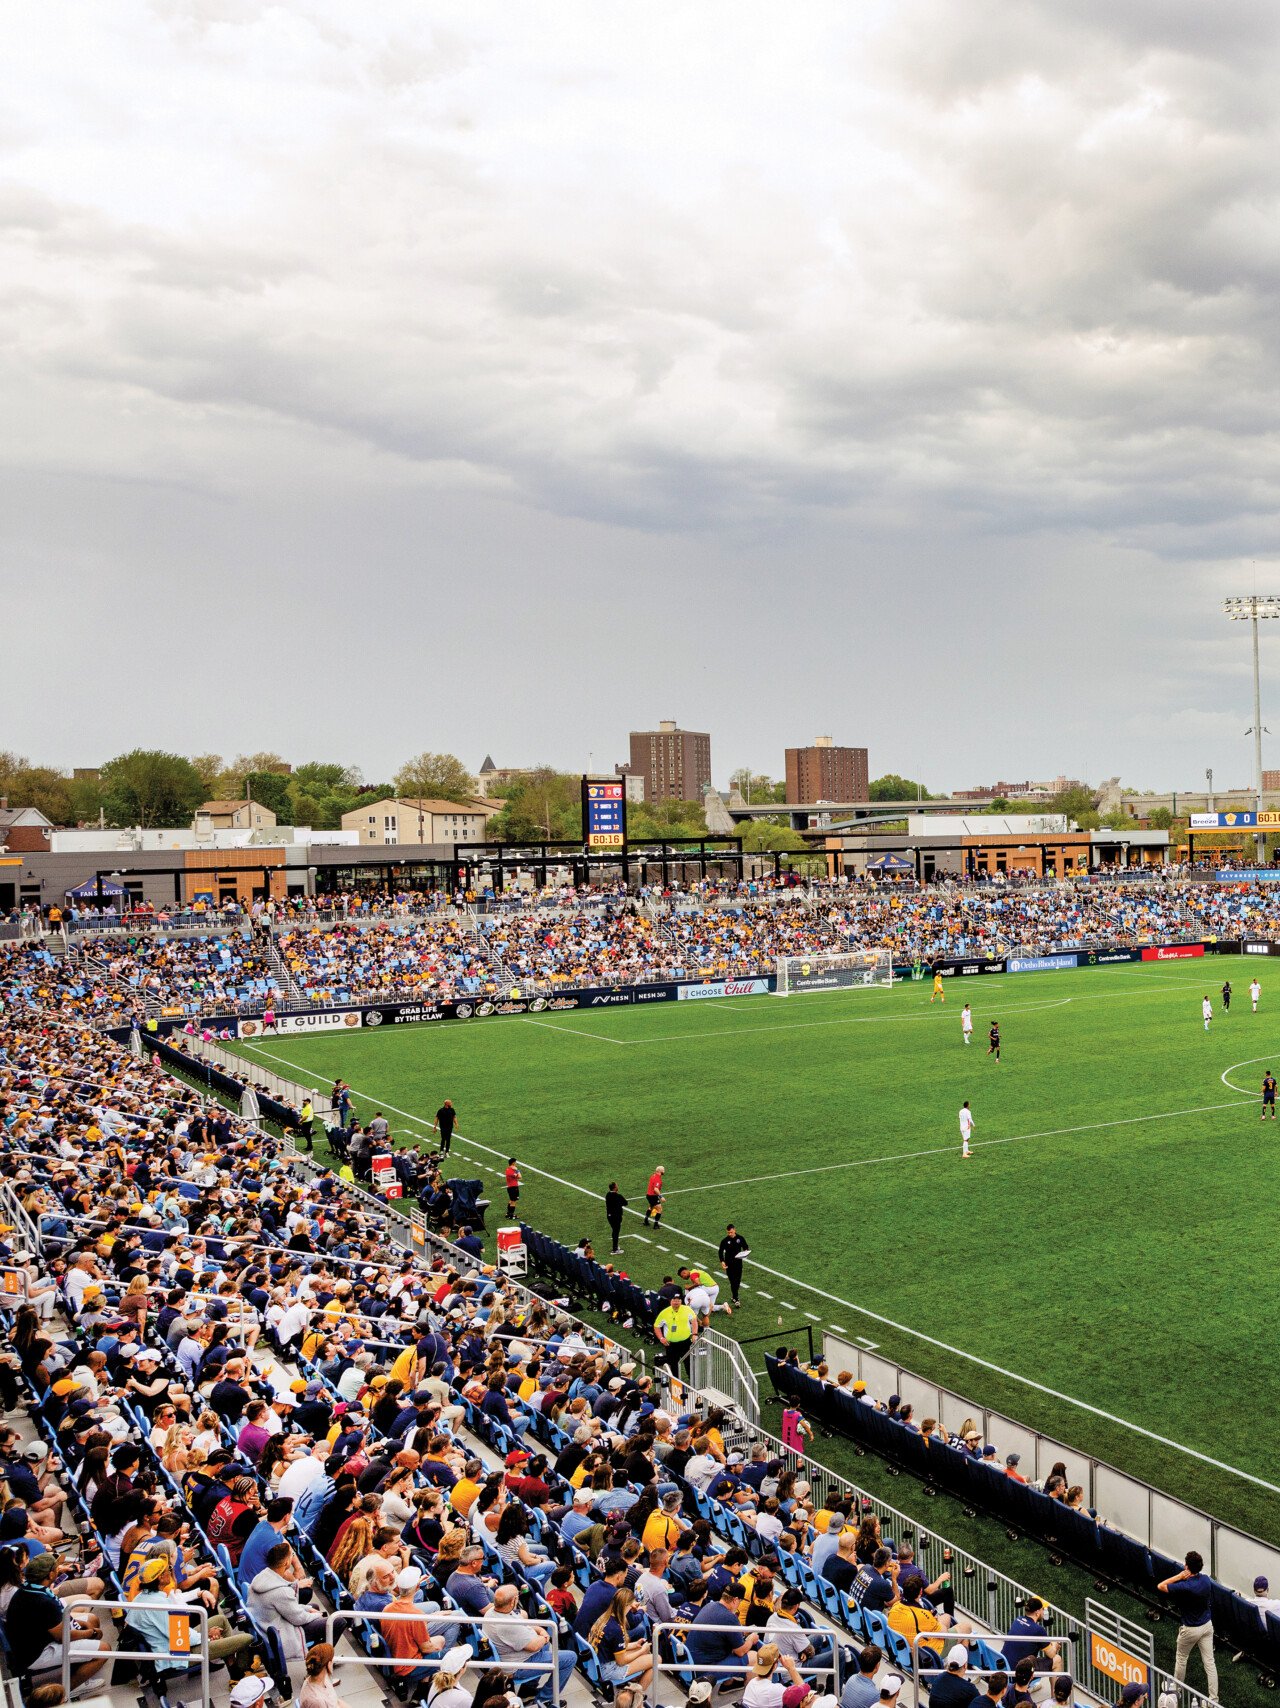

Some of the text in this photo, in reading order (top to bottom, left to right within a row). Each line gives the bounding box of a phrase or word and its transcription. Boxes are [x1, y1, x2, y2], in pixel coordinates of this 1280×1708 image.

[1243, 813, 1250, 823] 0
[593, 835, 620, 844] 60:16
[1021, 958, 1073, 969] Ortho Rhode Island
[690, 982, 756, 997] CHOOSE Chill
[400, 1007, 420, 1015] GRAB
[294, 1014, 341, 1027] GUILD
[389, 1188, 398, 1197] G
[175, 1619, 184, 1647] 110
[1094, 1643, 1143, 1684] 109-110
